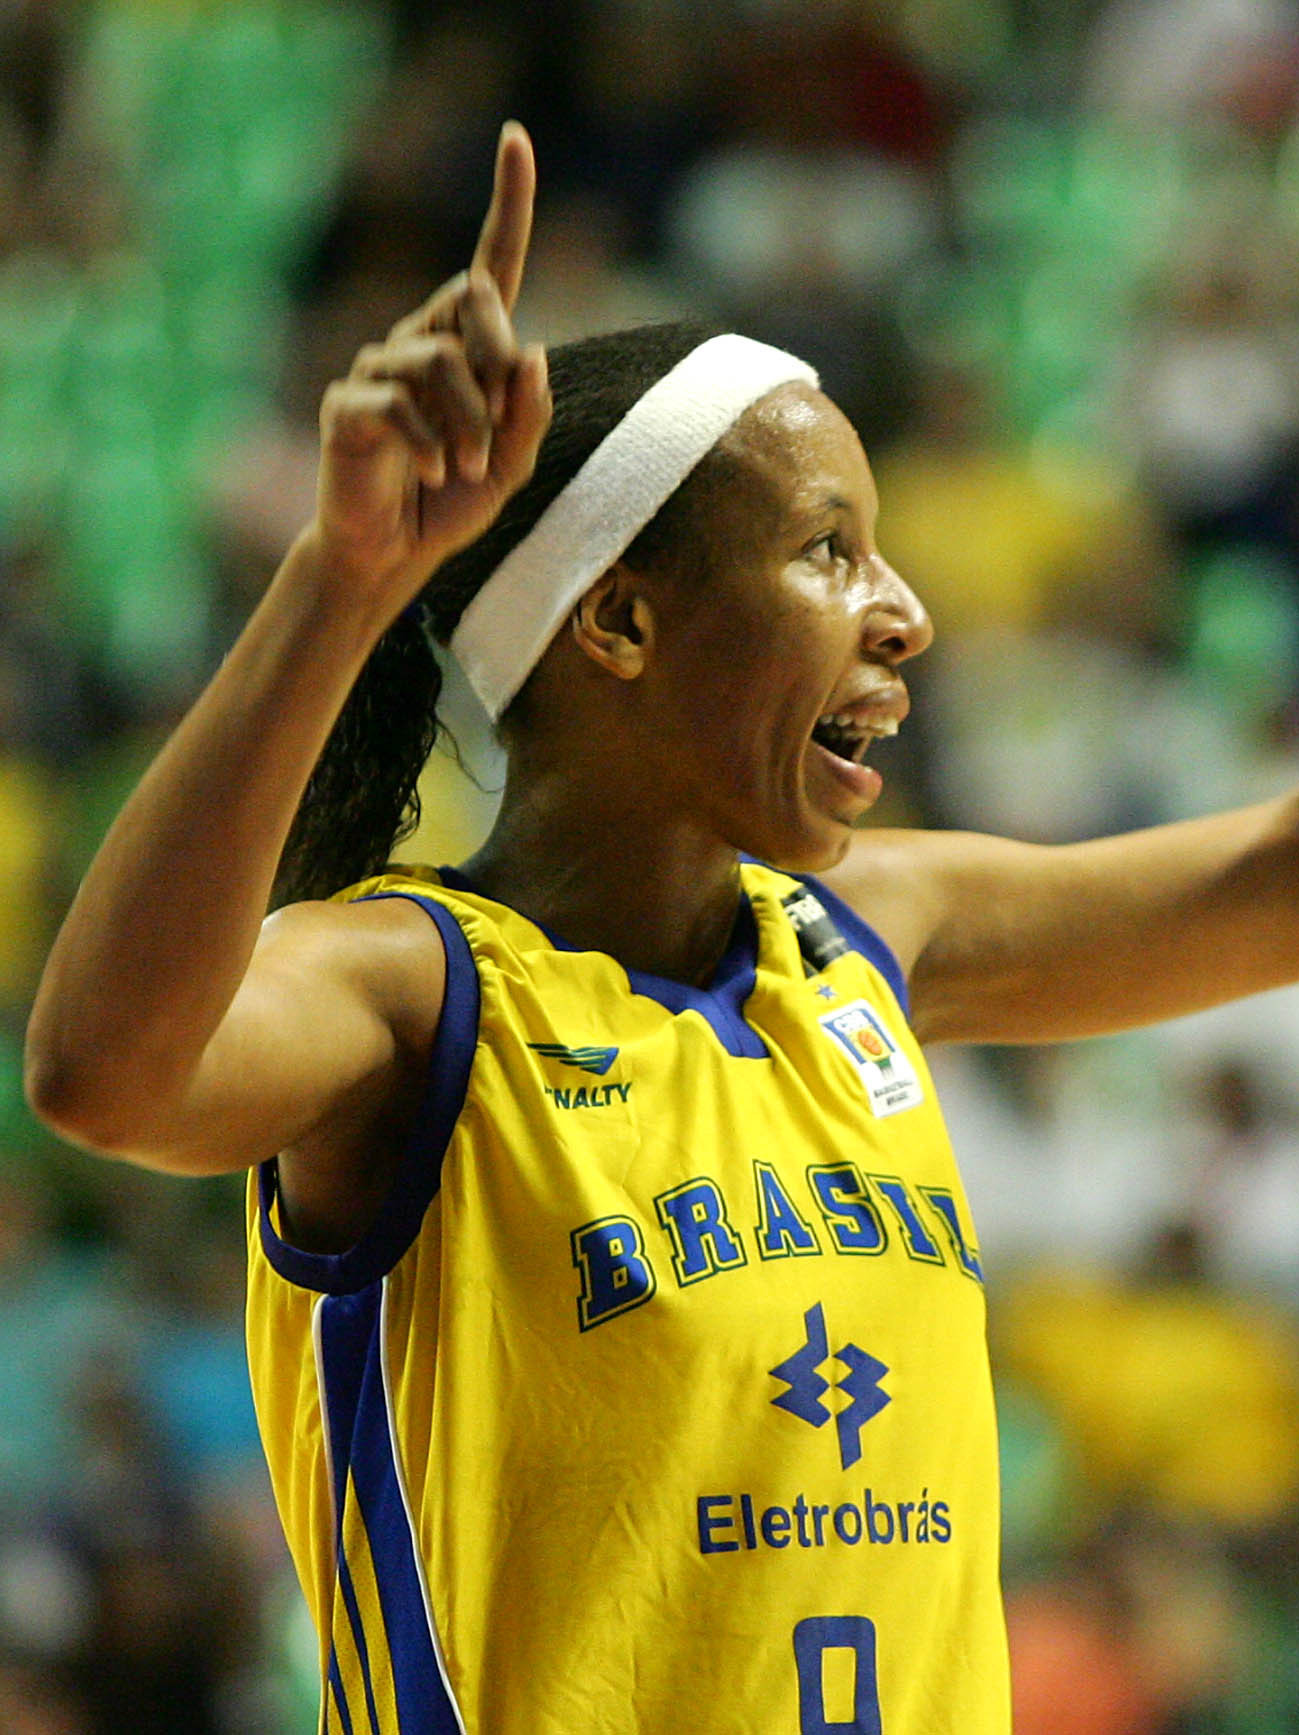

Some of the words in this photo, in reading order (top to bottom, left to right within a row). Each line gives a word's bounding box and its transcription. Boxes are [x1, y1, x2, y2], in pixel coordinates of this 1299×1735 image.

[544, 1080, 633, 1110] NALTY
[570, 1160, 985, 1332] BRASIL
[697, 1488, 952, 1555] Eletrobrás
